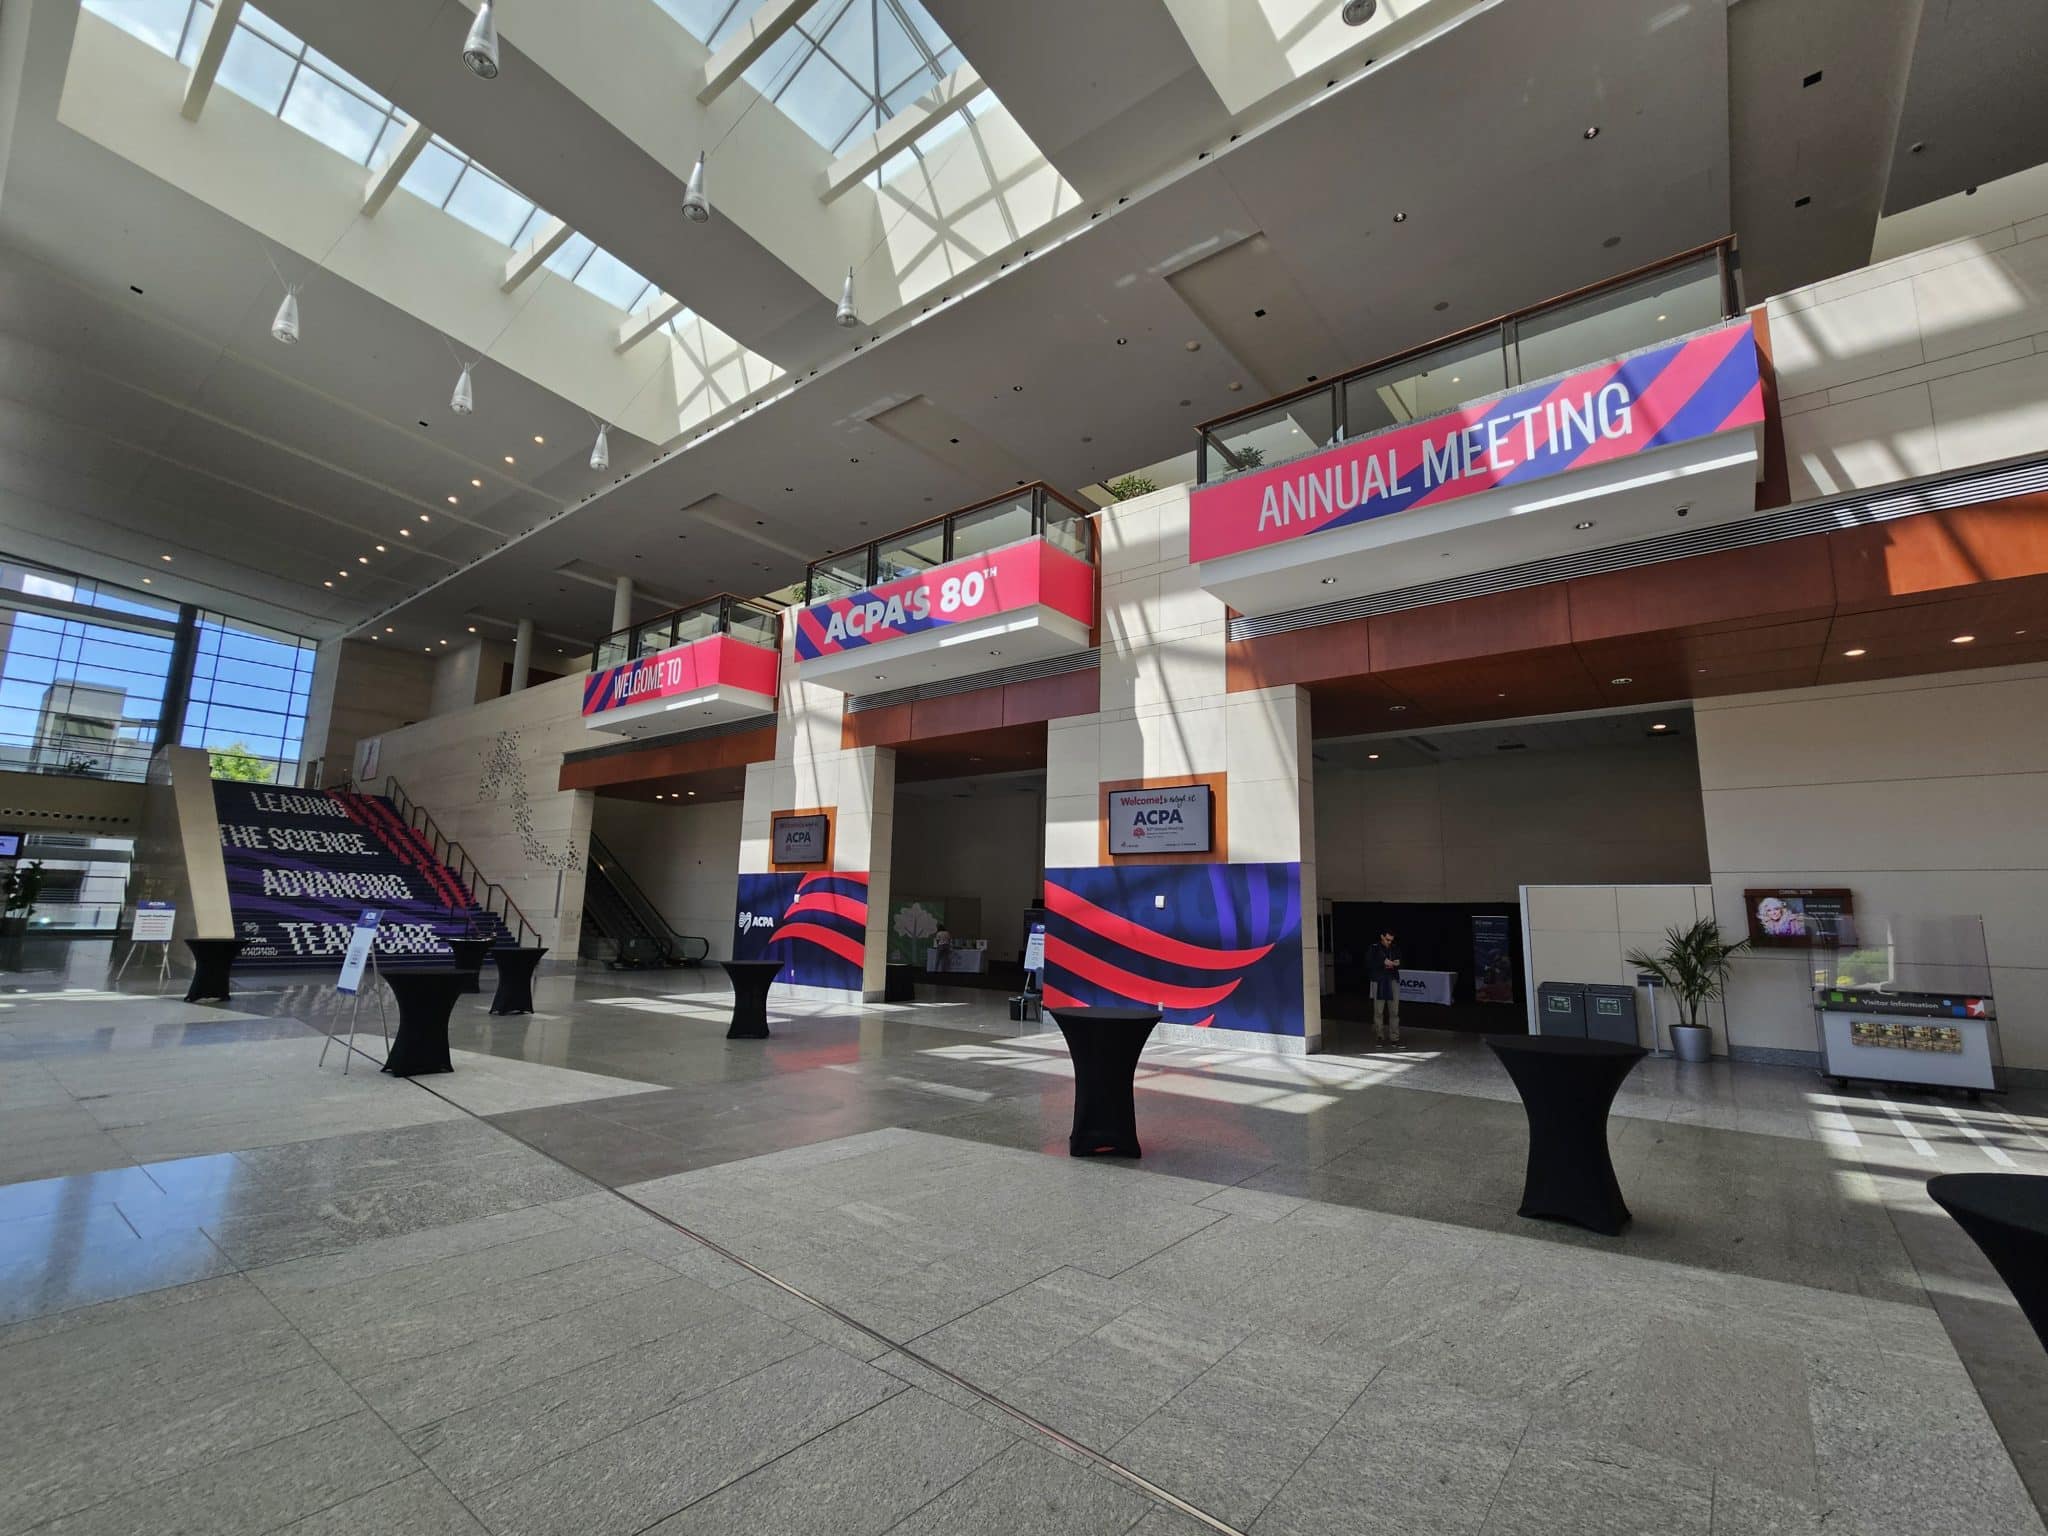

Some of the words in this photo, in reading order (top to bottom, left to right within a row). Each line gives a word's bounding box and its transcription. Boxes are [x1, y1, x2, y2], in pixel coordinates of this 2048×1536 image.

[1257, 448, 1412, 532] ANNUAL
[1422, 382, 1633, 489] MEETING
[824, 586, 931, 645] ACPA'S
[614, 662, 664, 700] WELCOME
[667, 657, 682, 686] TO
[1133, 809, 1183, 826] ACPA
[219, 824, 268, 849] THE
[267, 826, 379, 856] SCIENCE.
[785, 831, 811, 844] ACPA
[752, 916, 774, 928] ACPA
[1399, 979, 1426, 990] ACPA
[1862, 999, 1889, 1008] Visitor
